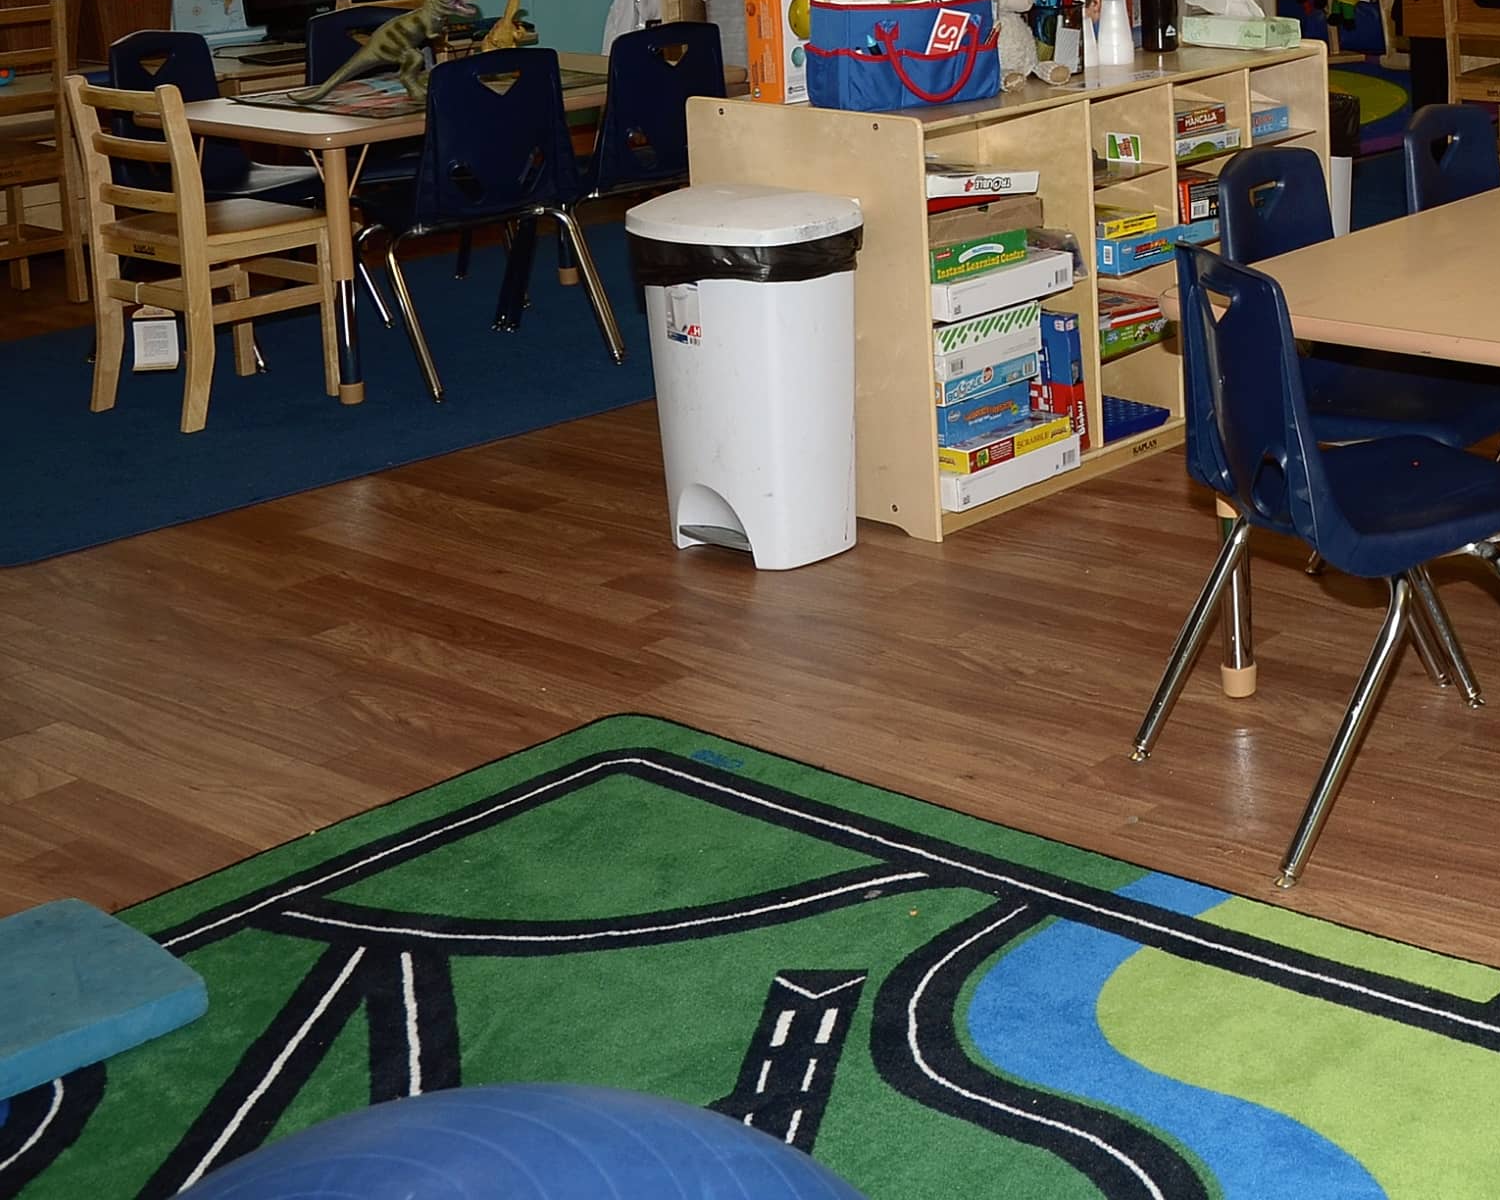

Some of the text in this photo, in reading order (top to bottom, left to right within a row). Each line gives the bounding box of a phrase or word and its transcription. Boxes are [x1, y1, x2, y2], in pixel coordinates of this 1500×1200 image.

[1184, 113, 1218, 127] MANCALA
[975, 176, 1012, 191] TROUBLE
[937, 264, 965, 280] Instant
[965, 254, 1000, 273] Learning
[1000, 249, 1026, 263] Center
[1016, 430, 1049, 450] SCRABBLE
